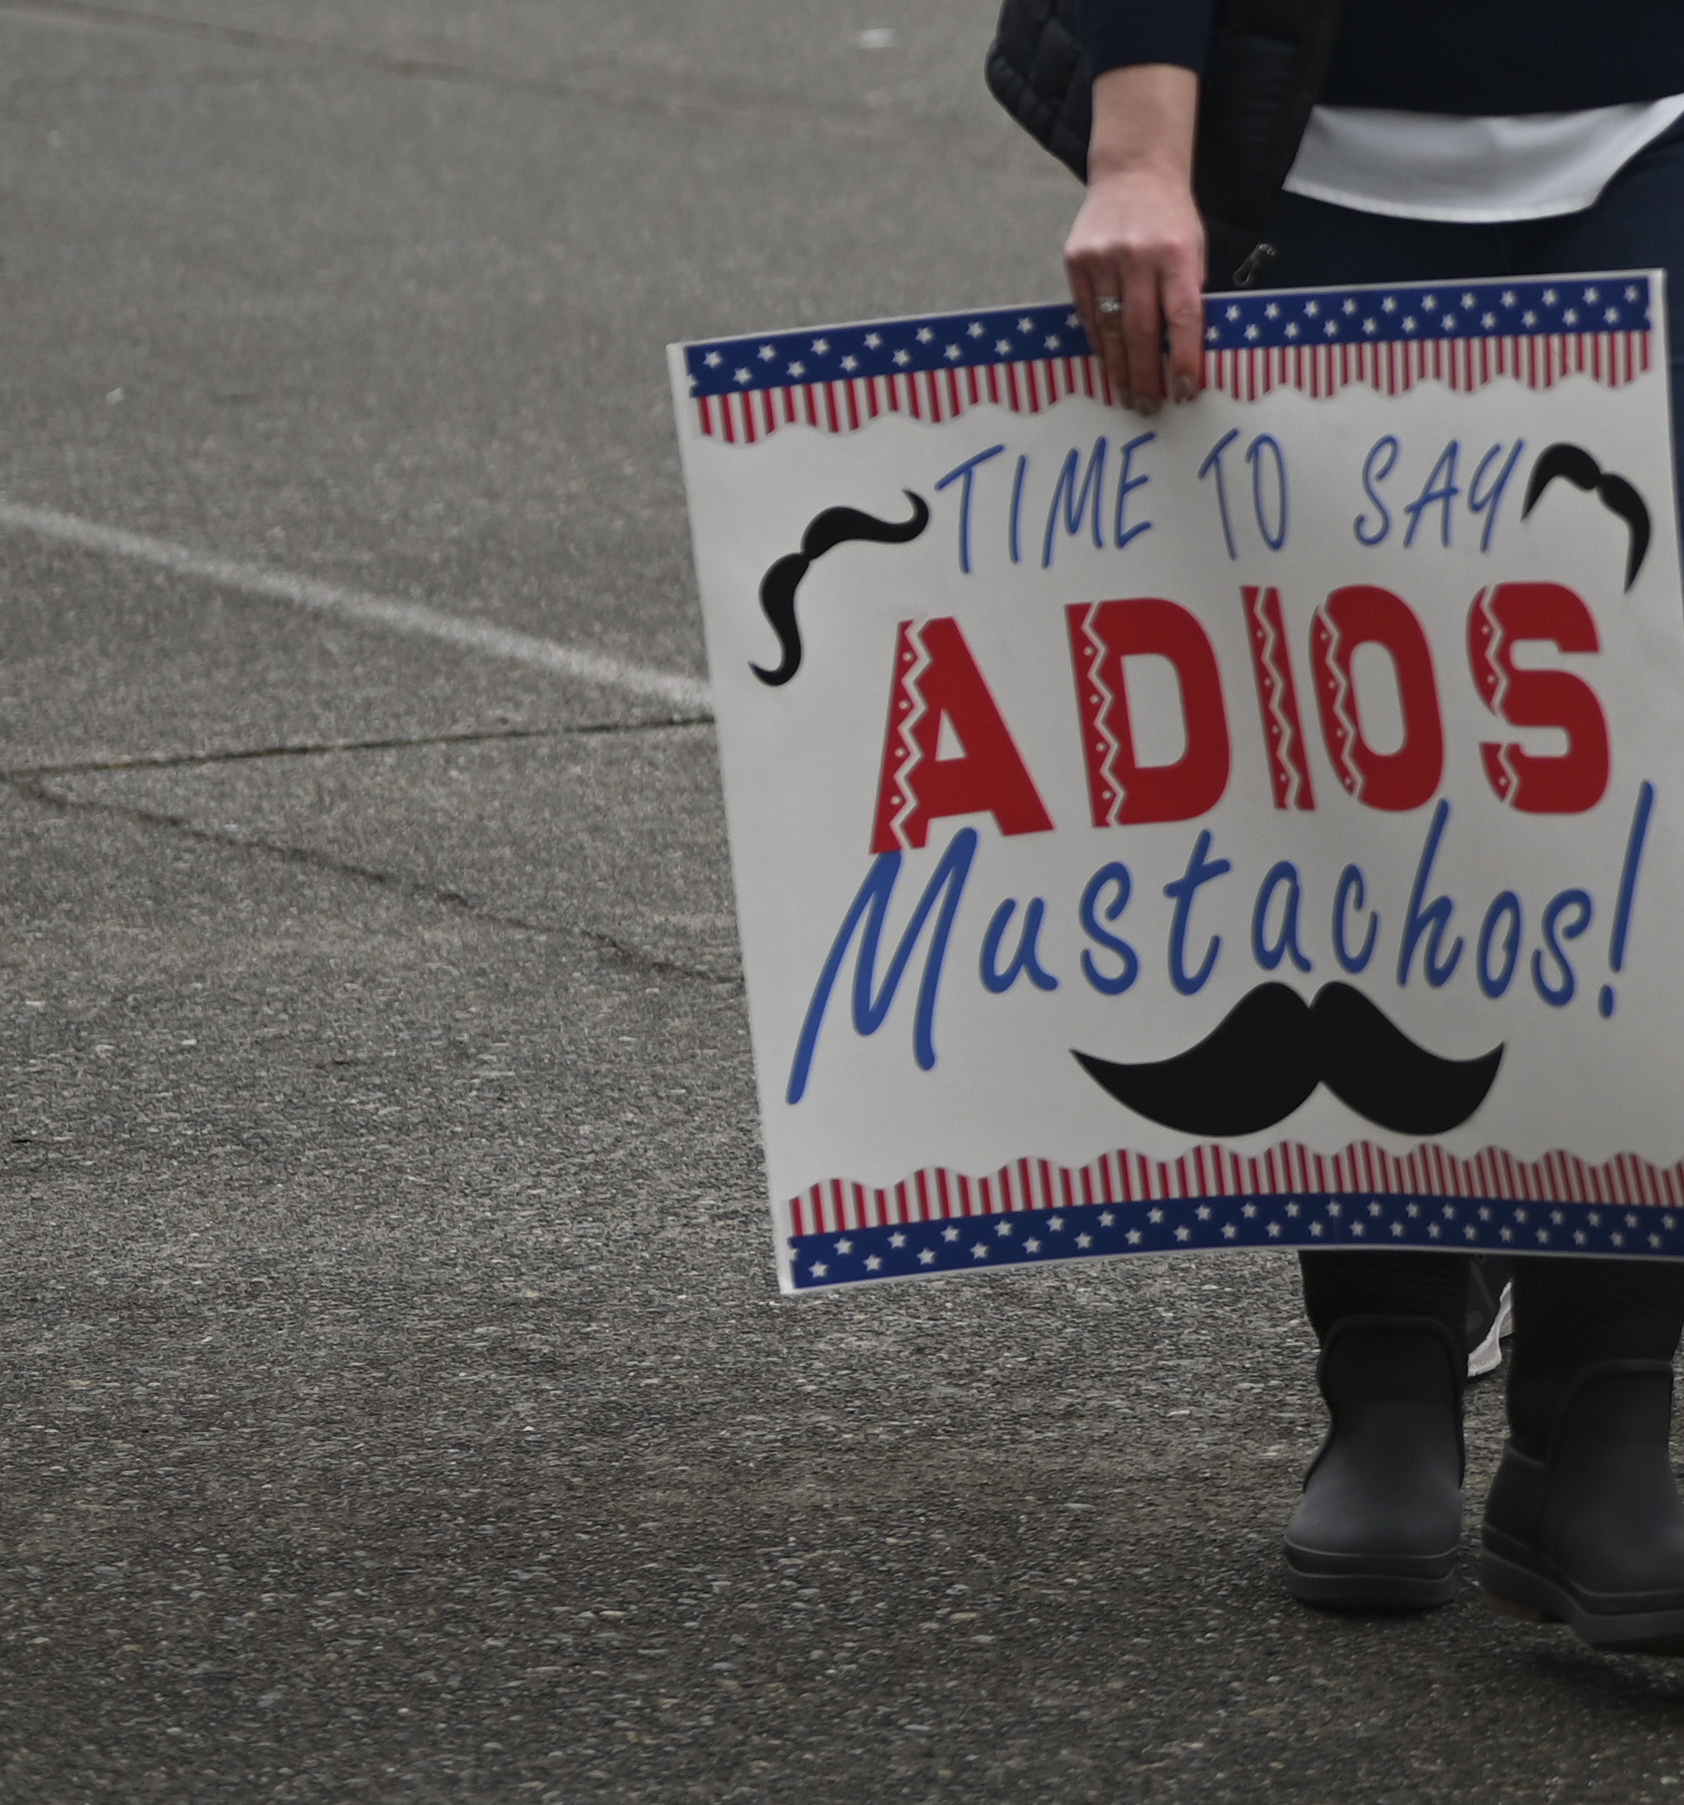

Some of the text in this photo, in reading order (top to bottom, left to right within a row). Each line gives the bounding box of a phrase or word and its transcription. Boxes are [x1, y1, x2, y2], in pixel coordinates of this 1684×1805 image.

[935, 429, 1523, 573] TIME TO SAY
[870, 581, 1610, 855] ADIOS
[786, 780, 1654, 1105] Mustachos!
